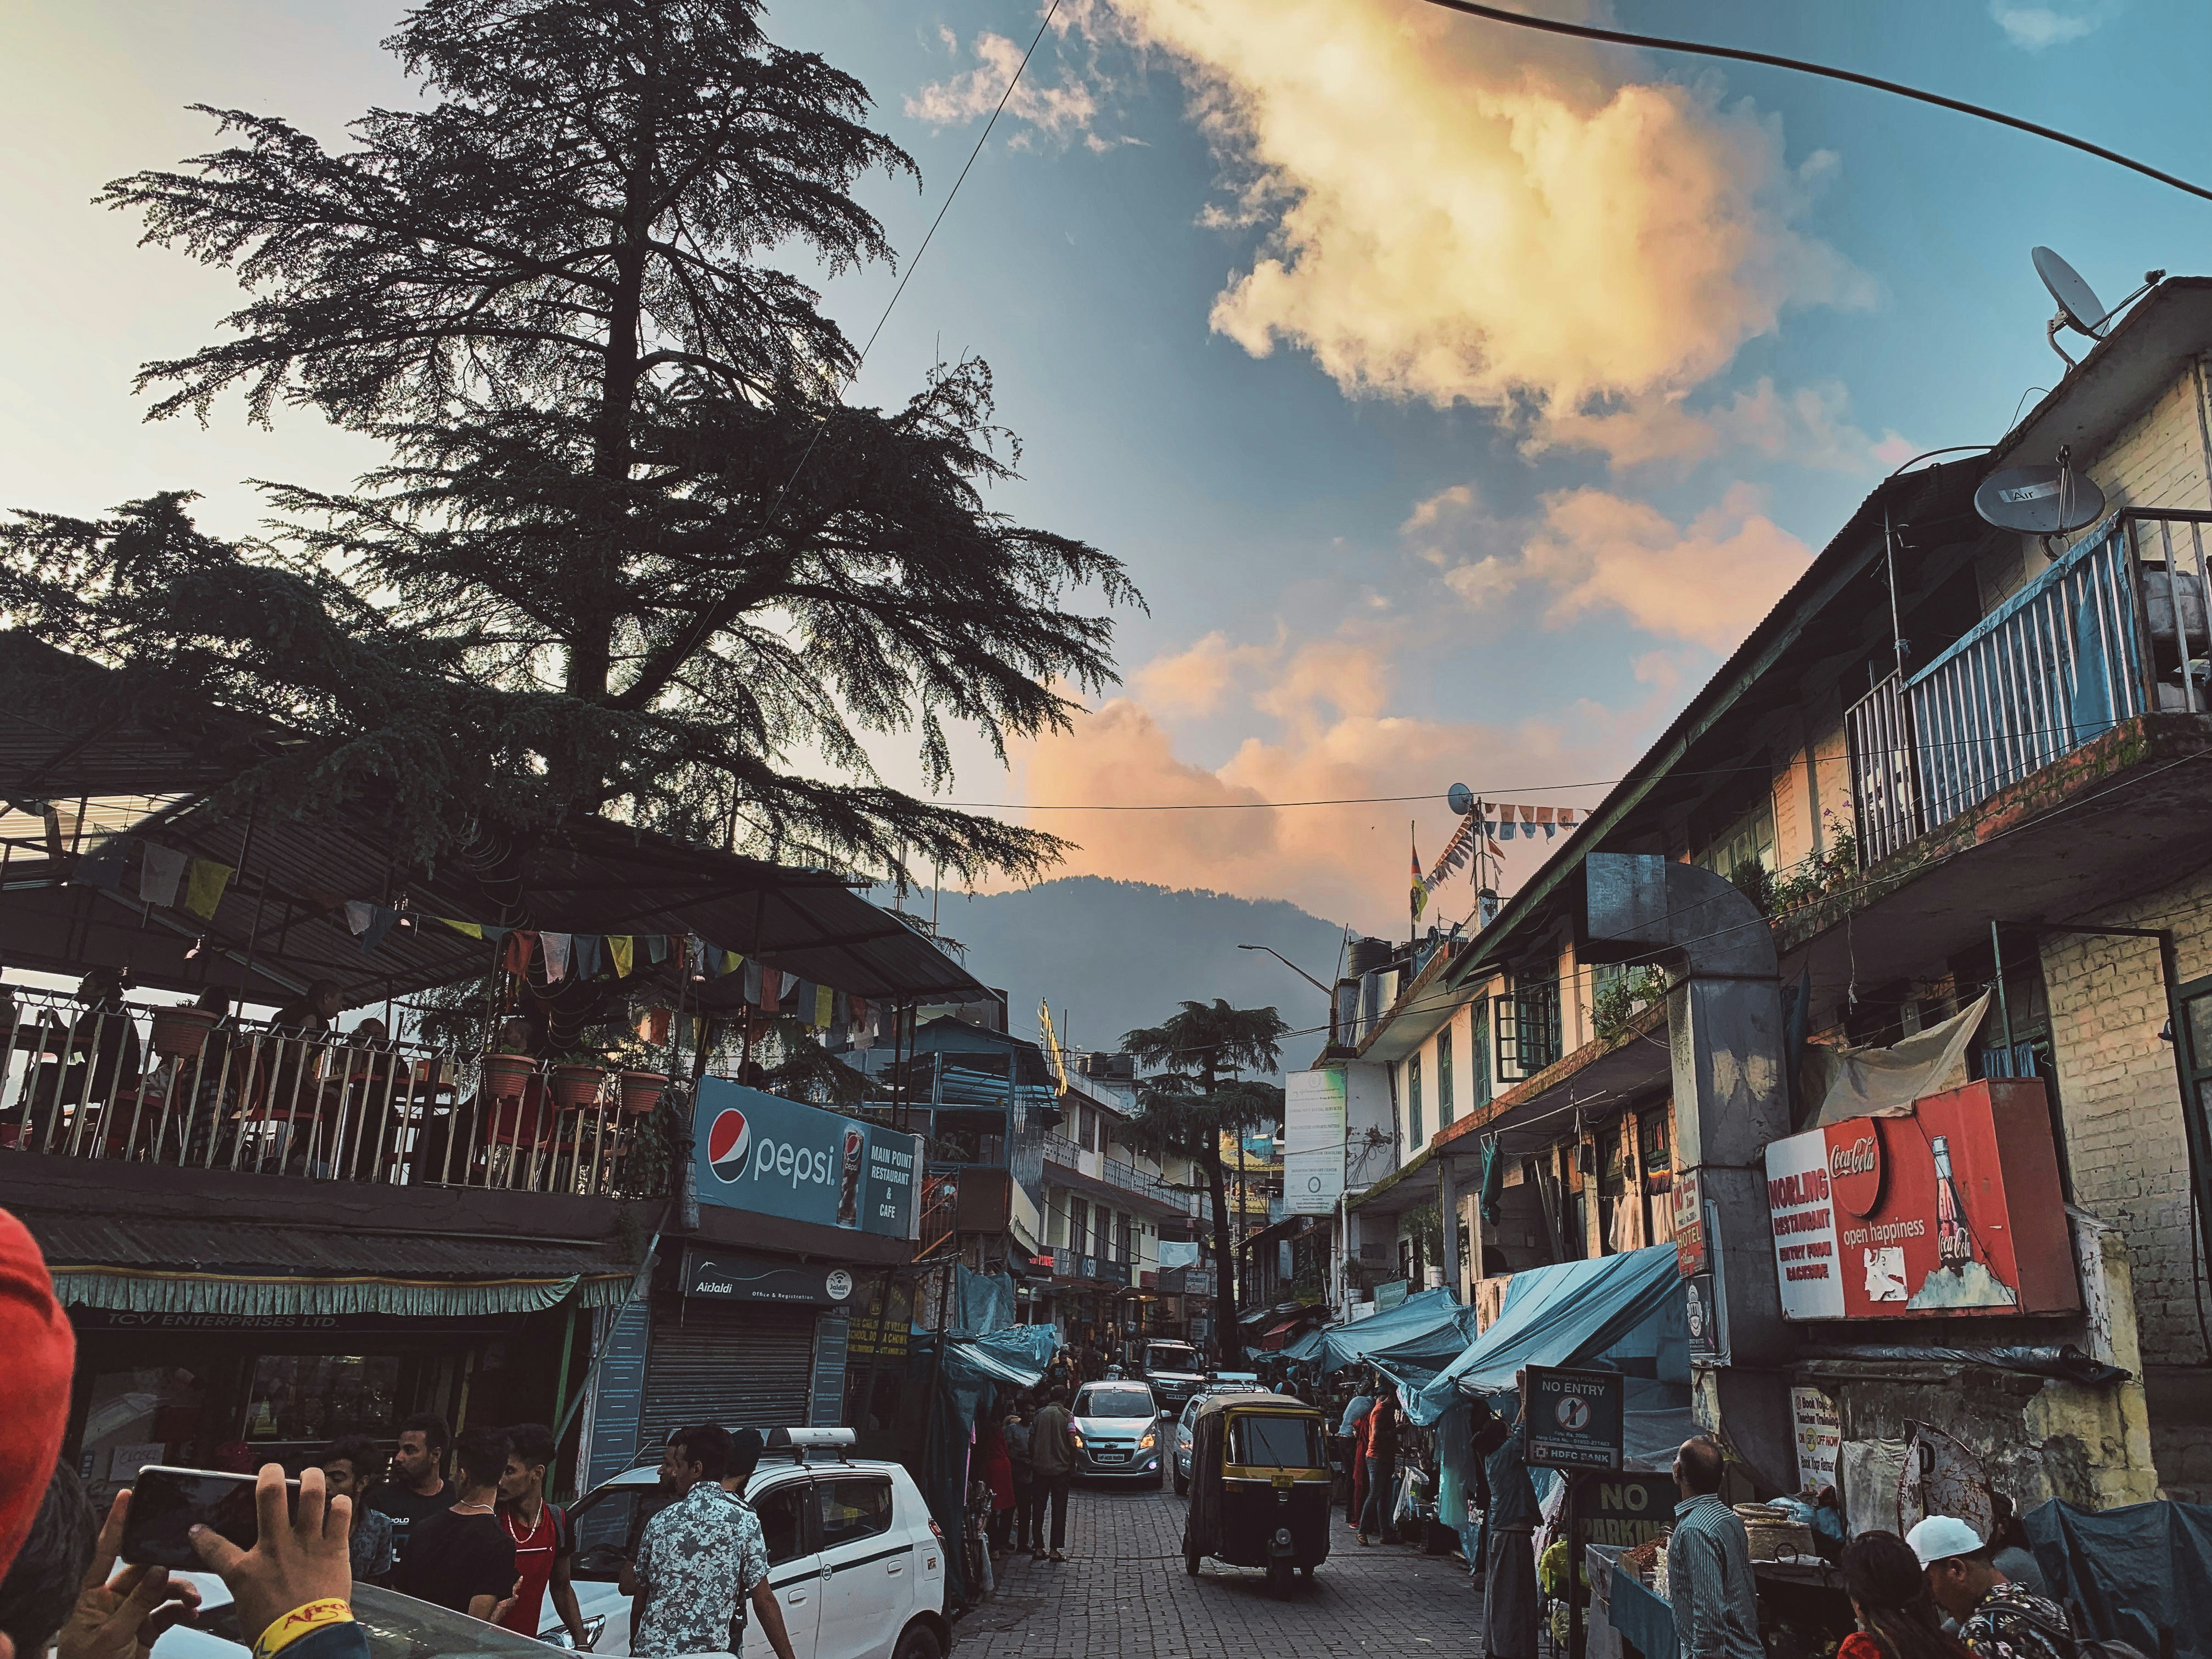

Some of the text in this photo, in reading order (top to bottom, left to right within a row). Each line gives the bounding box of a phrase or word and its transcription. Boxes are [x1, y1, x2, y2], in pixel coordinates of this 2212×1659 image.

[754, 1138, 834, 1189] pepsi
[871, 1145, 912, 1169] MAIN POINT
[1830, 1136, 1875, 1178] Coca-Cola
[871, 1165, 910, 1185] RESTAURANT
[886, 1187, 891, 1200] &
[1674, 1185, 1683, 1212] NO
[1768, 1168, 1829, 1210] NORLING
[879, 1204, 895, 1218] CAFE
[1677, 1226, 1701, 1250] HOTEL
[1843, 1217, 1925, 1250] open happiness
[1087, 1258, 1097, 1278] SBI
[696, 1282, 733, 1294] AirJaldi
[109, 1313, 340, 1327] TCV ENTERPRISES LTD.
[1542, 1380, 1605, 1396] NO ENTRY
[1802, 1397, 1815, 1409] Book
[1815, 1413, 1839, 1430] Training
[1817, 1435, 1825, 1446] OFF
[1826, 1435, 1839, 1447] NOW
[1551, 1449, 1609, 1463] HDFC BANK
[1600, 1482, 1648, 1511] NO
